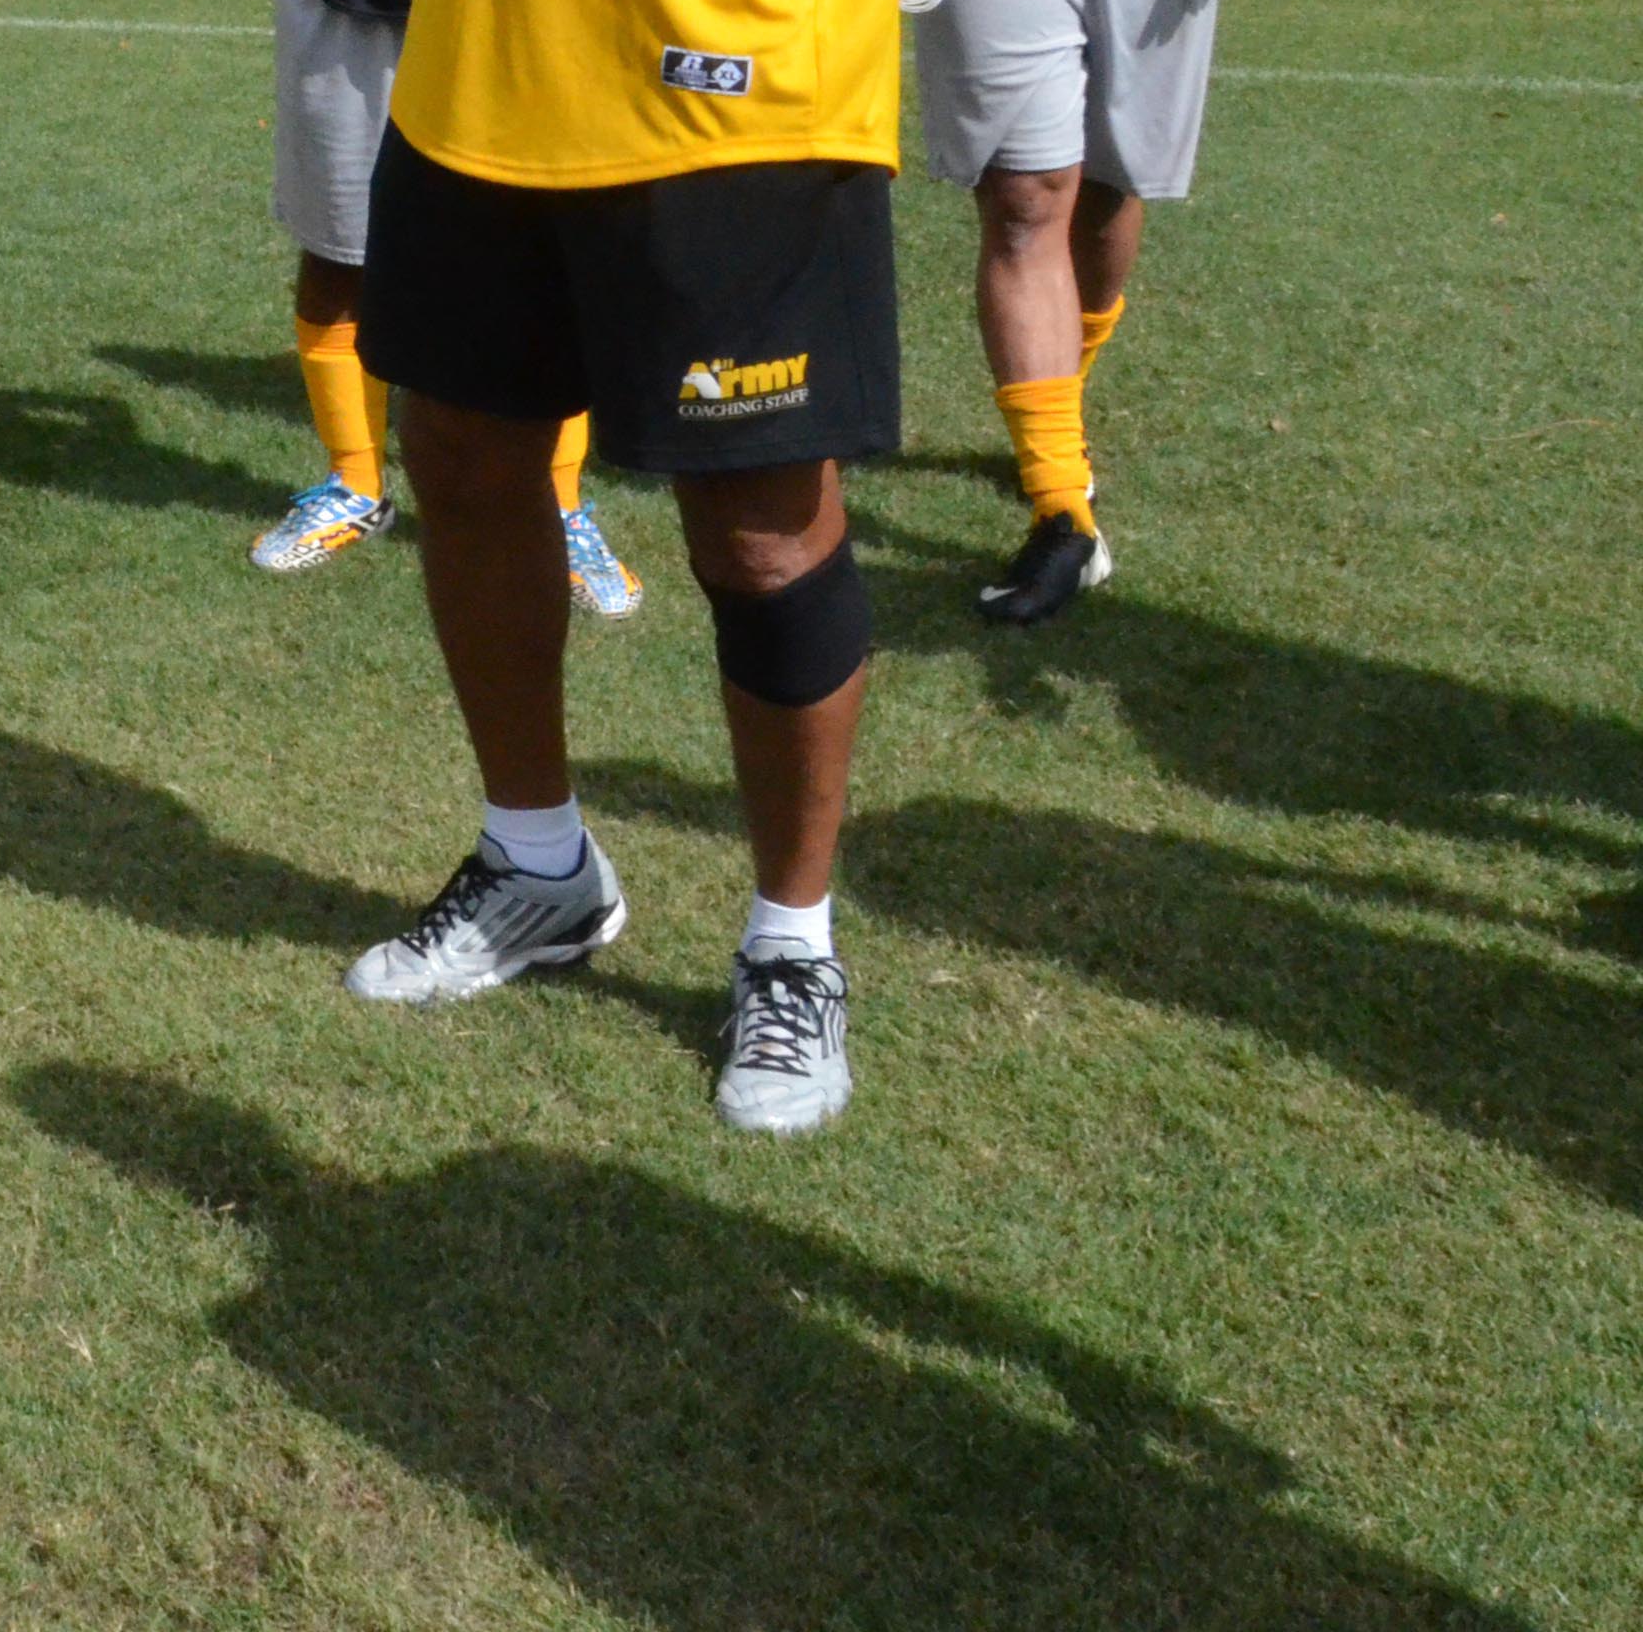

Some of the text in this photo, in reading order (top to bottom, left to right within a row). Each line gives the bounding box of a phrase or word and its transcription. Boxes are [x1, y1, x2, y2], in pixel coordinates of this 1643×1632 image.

[678, 353, 809, 400] Army
[678, 387, 810, 418] COACHING STAFF
